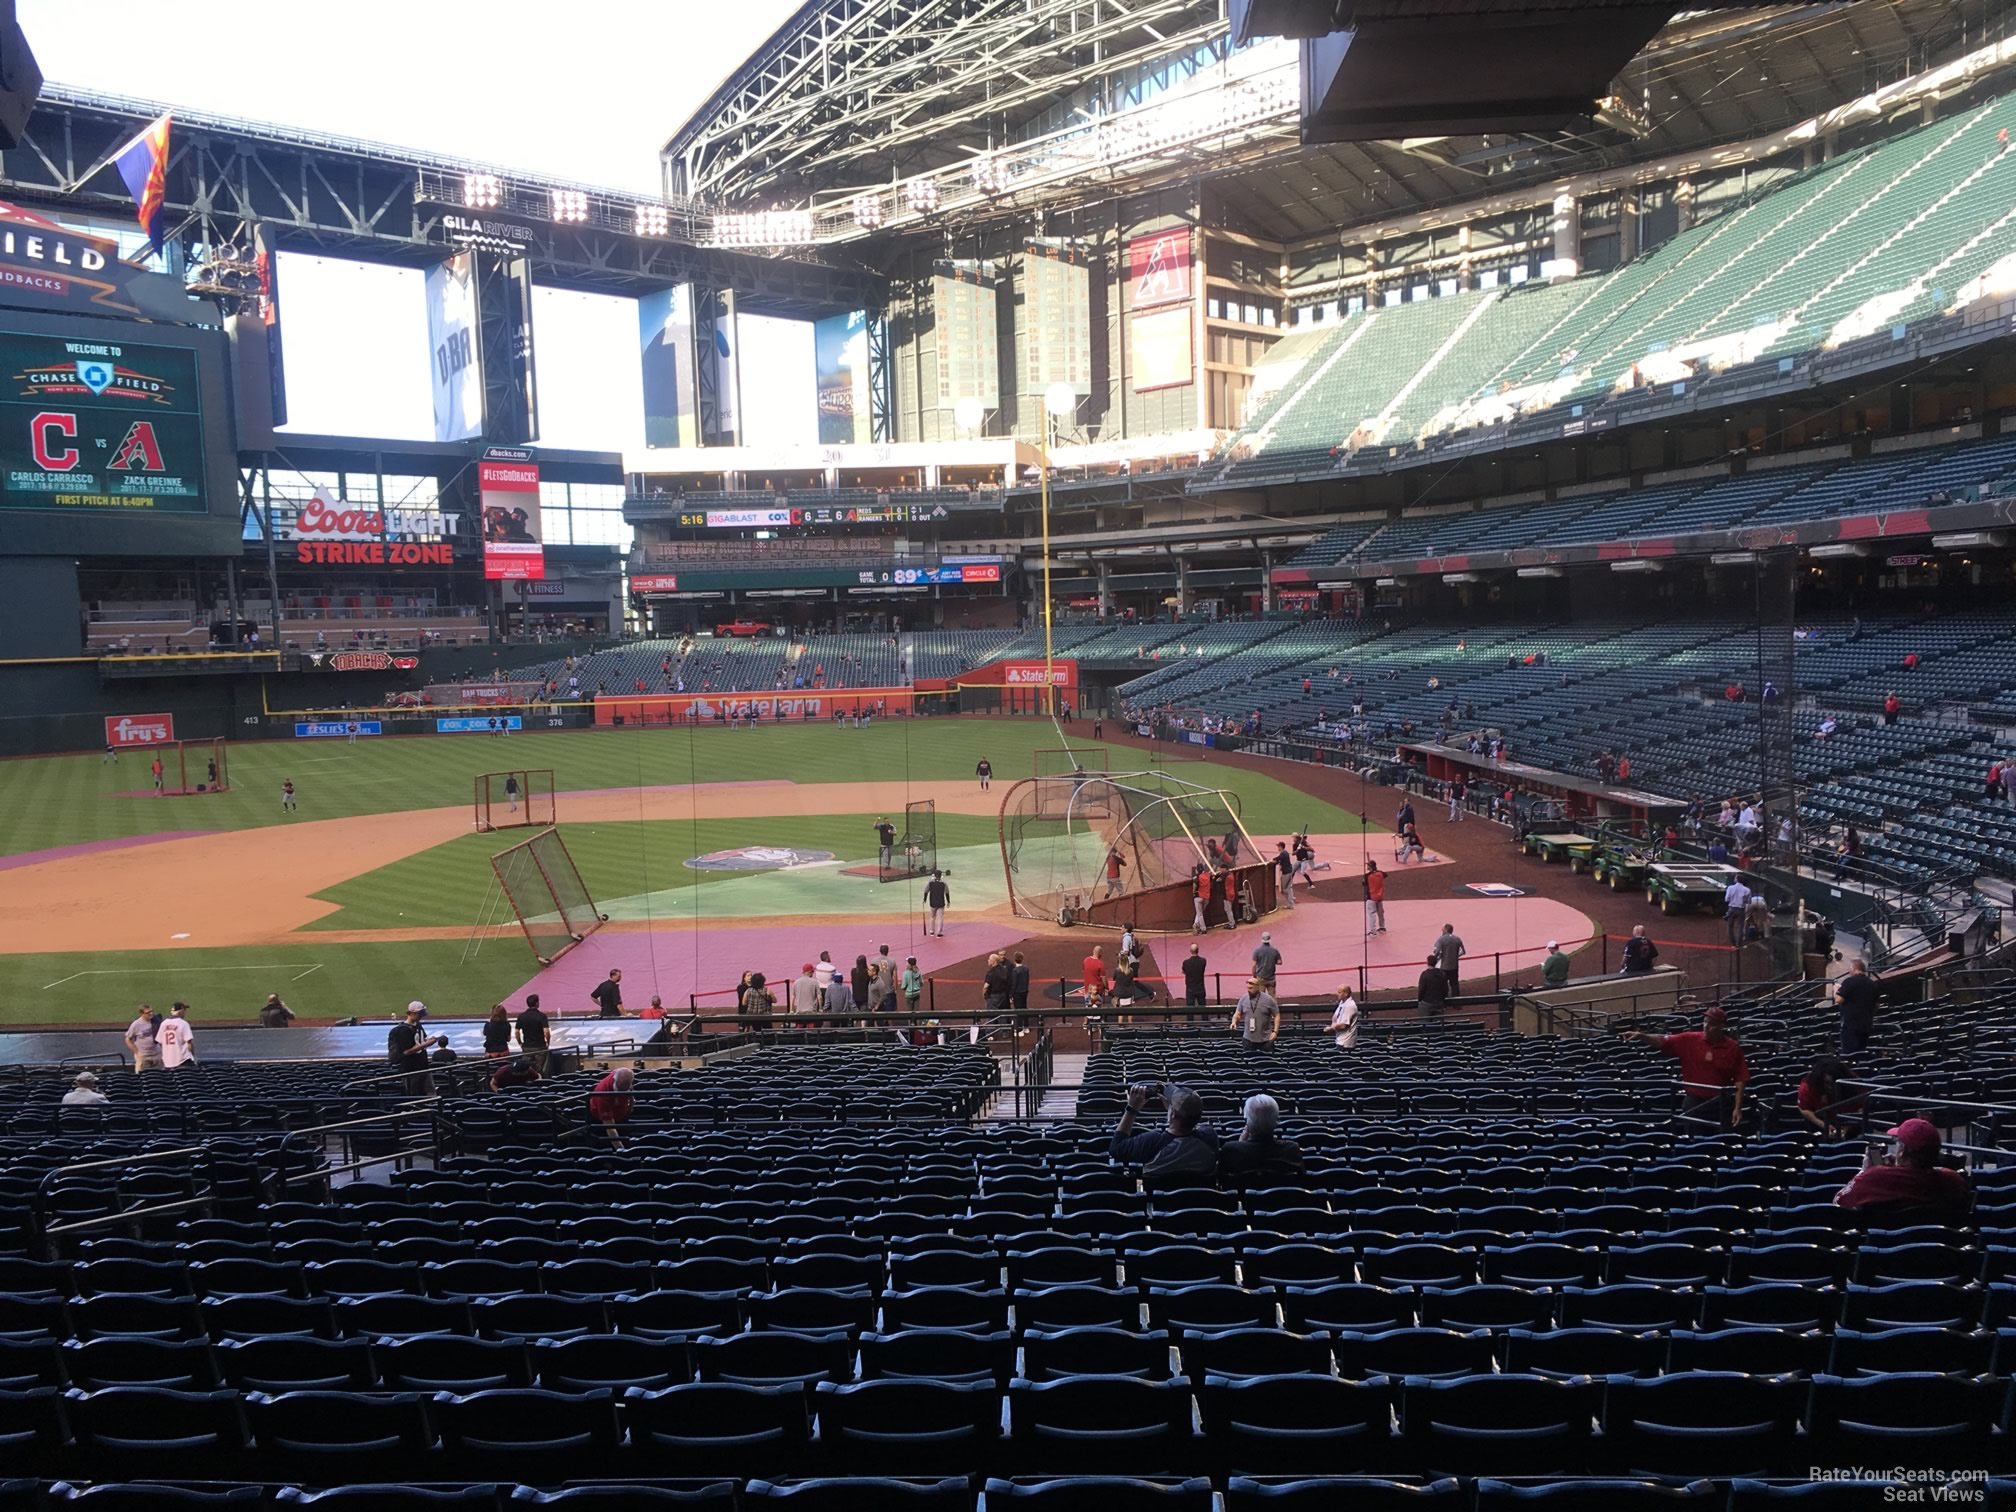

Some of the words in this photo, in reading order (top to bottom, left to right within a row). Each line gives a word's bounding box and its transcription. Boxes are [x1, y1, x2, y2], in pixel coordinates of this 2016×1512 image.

[443, 215, 482, 233] GILA
[483, 221, 533, 240] RIVER
[462, 243, 519, 256] CASINOS
[0, 272, 62, 290] DBACKS
[65, 343, 109, 355] WELCOME
[110, 346, 122, 357] TO
[30, 374, 76, 383] CHASE
[117, 377, 160, 391] FIELD
[95, 438, 108, 449] VS
[490, 449, 527, 458] dbacks.com
[11, 471, 45, 482] CARLOS
[47, 473, 94, 484] CARRASCO
[123, 475, 146, 486] ZACK
[147, 477, 183, 488] GREINKE
[483, 469, 537, 482] #LETSGODBACKS
[56, 494, 81, 505] FIRST
[83, 495, 110, 505] PITCH
[110, 496, 122, 506] AT
[296, 498, 386, 533] Coors
[388, 511, 460, 534] LIGHT
[681, 515, 704, 525] 5:16
[804, 511, 812, 521] 6
[835, 510, 843, 520] 6
[297, 542, 385, 563] STRIKE
[389, 543, 454, 564] ZONE
[658, 543, 679, 555] THE
[681, 542, 716, 555] DRAFT
[719, 541, 752, 553] ROOM
[770, 540, 806, 551] CRAFT
[806, 539, 835, 550] BEER
[850, 538, 881, 550] BITES
[882, 572, 889, 582] 0
[534, 585, 563, 594] FITNESS
[1021, 669, 1044, 682] State
[1044, 670, 1066, 682] Frm
[462, 687, 475, 699] RAM
[476, 688, 499, 698] TRUCKS
[772, 695, 821, 714] Farm
[243, 716, 259, 725] 413
[548, 718, 563, 727] 376
[113, 718, 167, 742] fry's
[306, 723, 344, 735] LESLIE'S
[165, 1032, 176, 1045] 12
